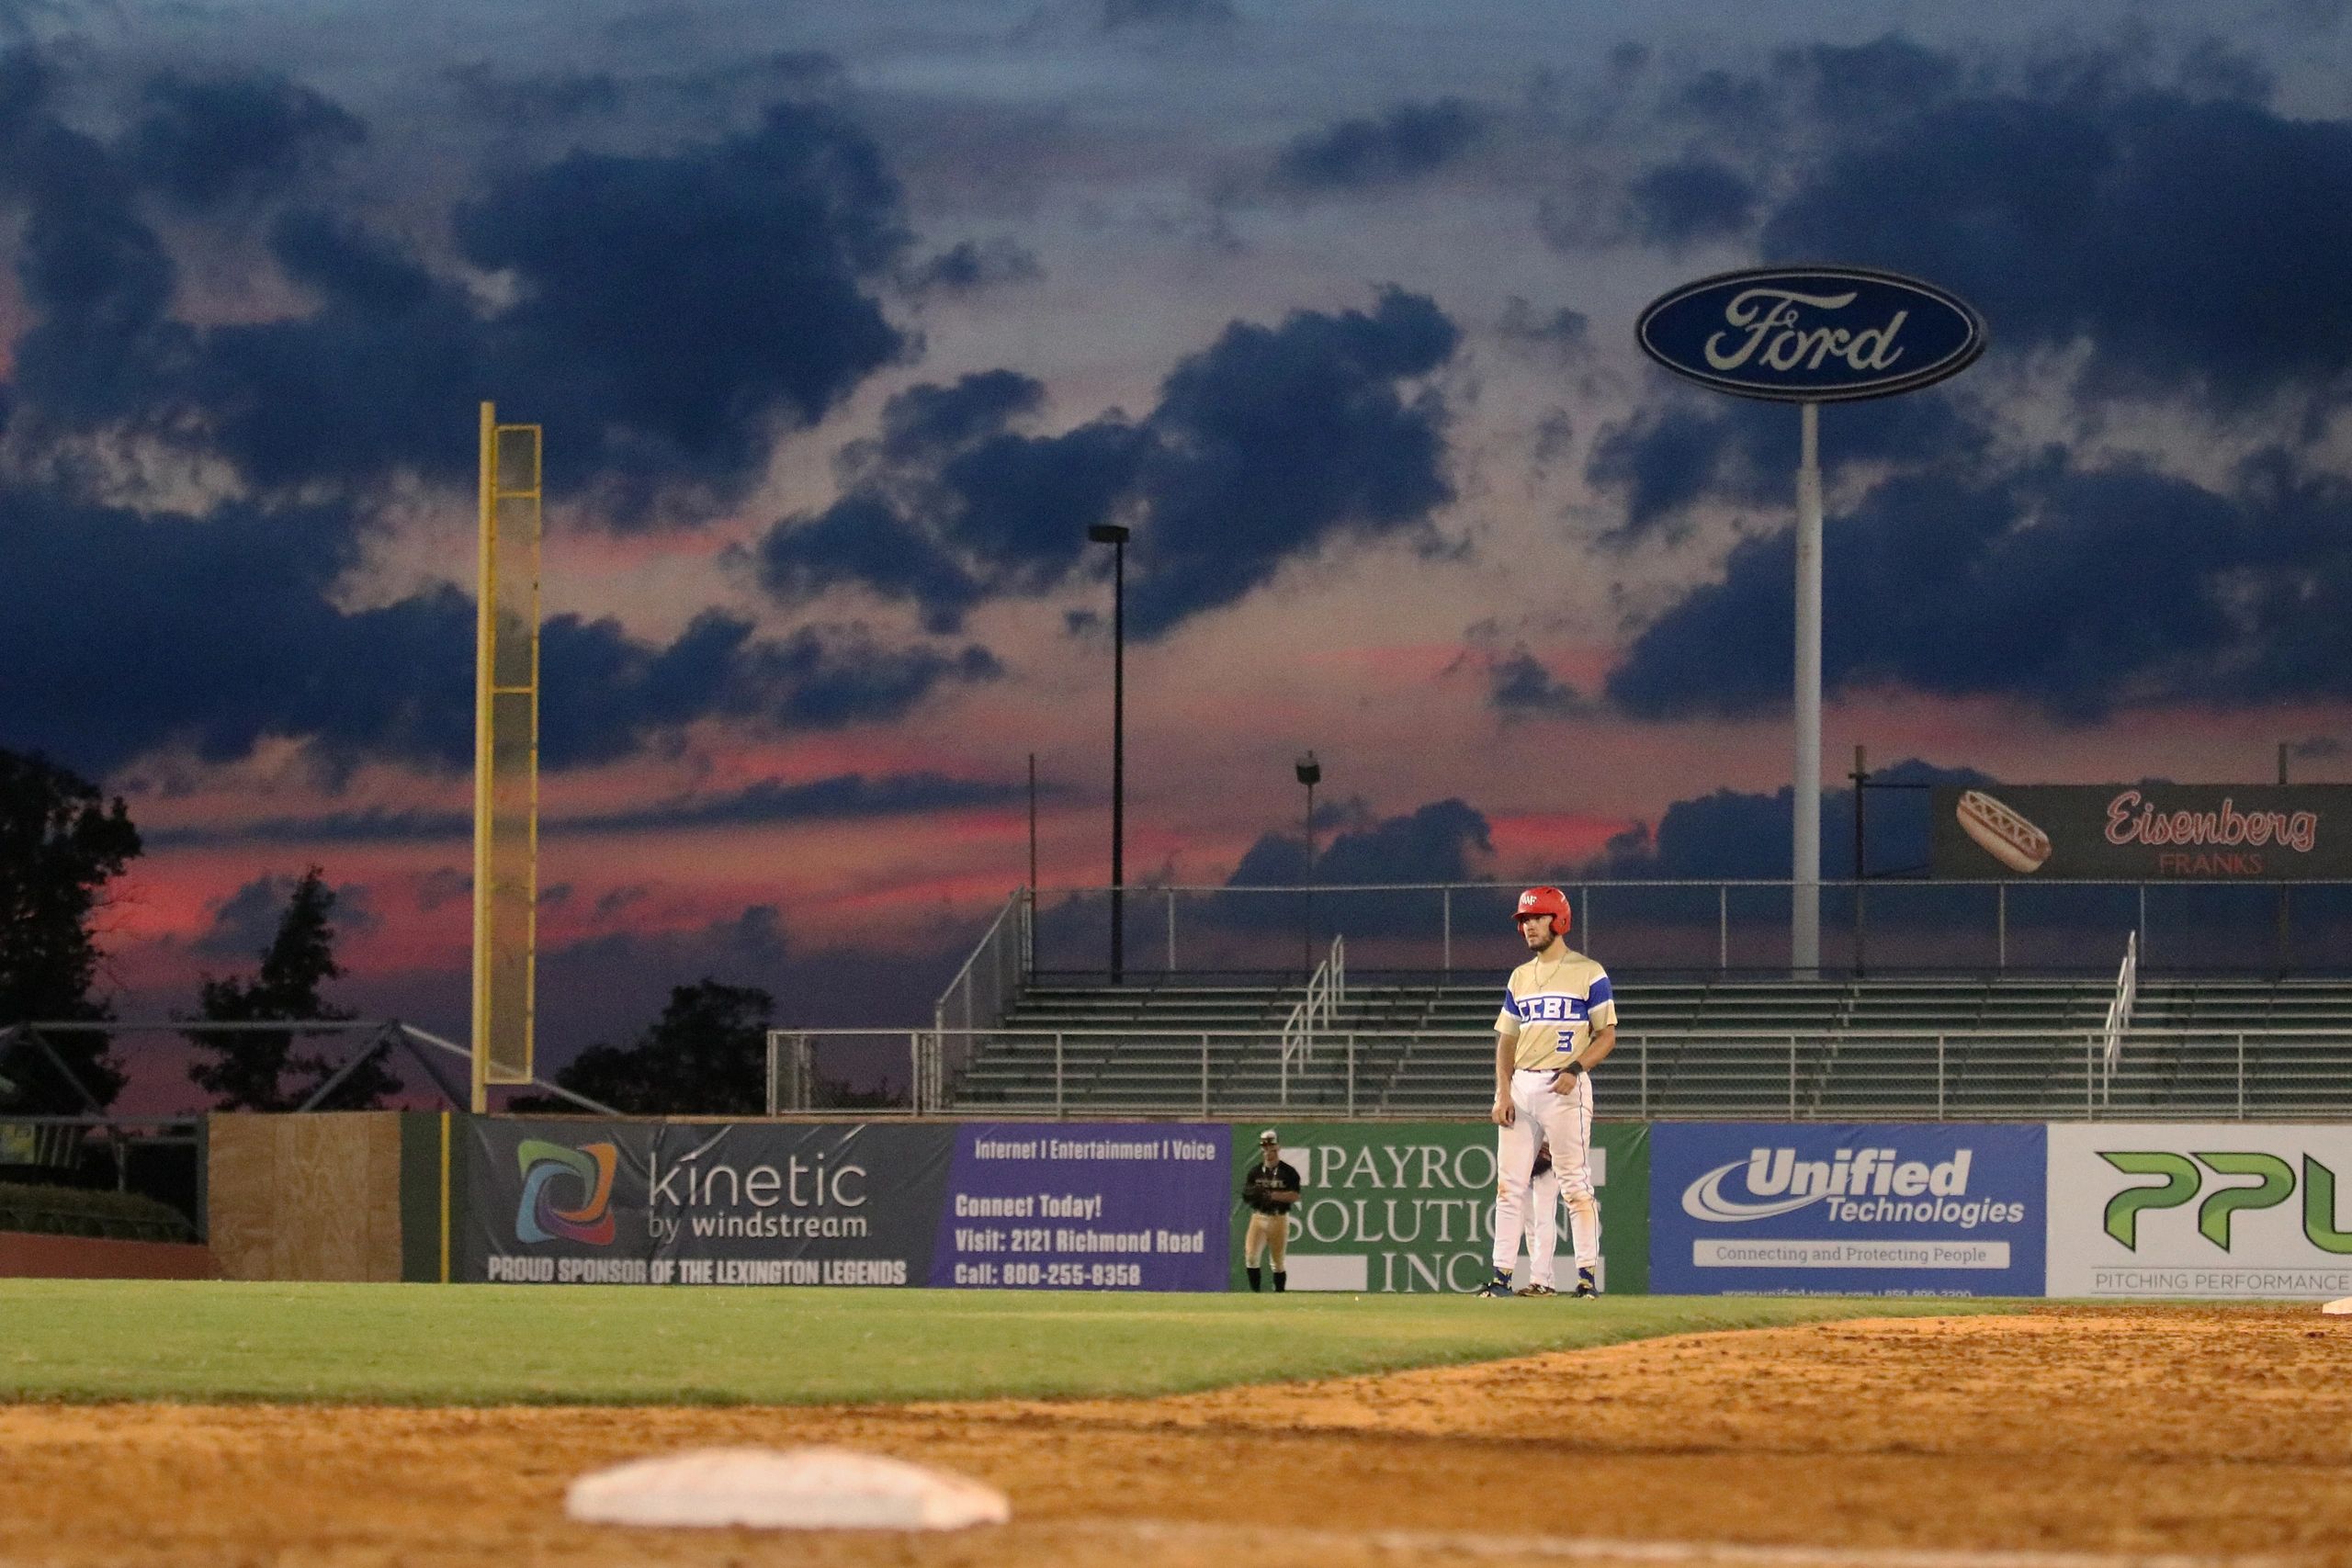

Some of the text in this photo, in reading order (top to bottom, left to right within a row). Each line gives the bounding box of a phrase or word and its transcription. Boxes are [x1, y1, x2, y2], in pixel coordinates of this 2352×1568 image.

[1705, 288, 1908, 371] Ford
[2104, 789, 2318, 852] Eisenberg
[2159, 852, 2264, 874] FRANKS
[1555, 1030, 1575, 1053] 3
[975, 1139, 1036, 1159] Internet
[1050, 1140, 1159, 1160] Entertainment
[1173, 1140, 1216, 1160] Voice
[650, 1153, 867, 1207] kinetic
[1746, 1147, 1973, 1196] Unified
[956, 1194, 1102, 1221] Connect Today!
[1826, 1196, 2024, 1229] Technologies
[649, 1211, 866, 1244] by windstream
[956, 1229, 1204, 1253] Visit: 2121 Richmond Road
[1716, 1247, 1986, 1264] Connecting and Protecting People
[488, 1256, 907, 1285] PROUD SPONSOR OF THE LEXINGTON LEGENDS
[955, 1263, 1141, 1286] Call: 800-255-8358
[2096, 1273, 2350, 1291] PITCHING PERFORMANCE
